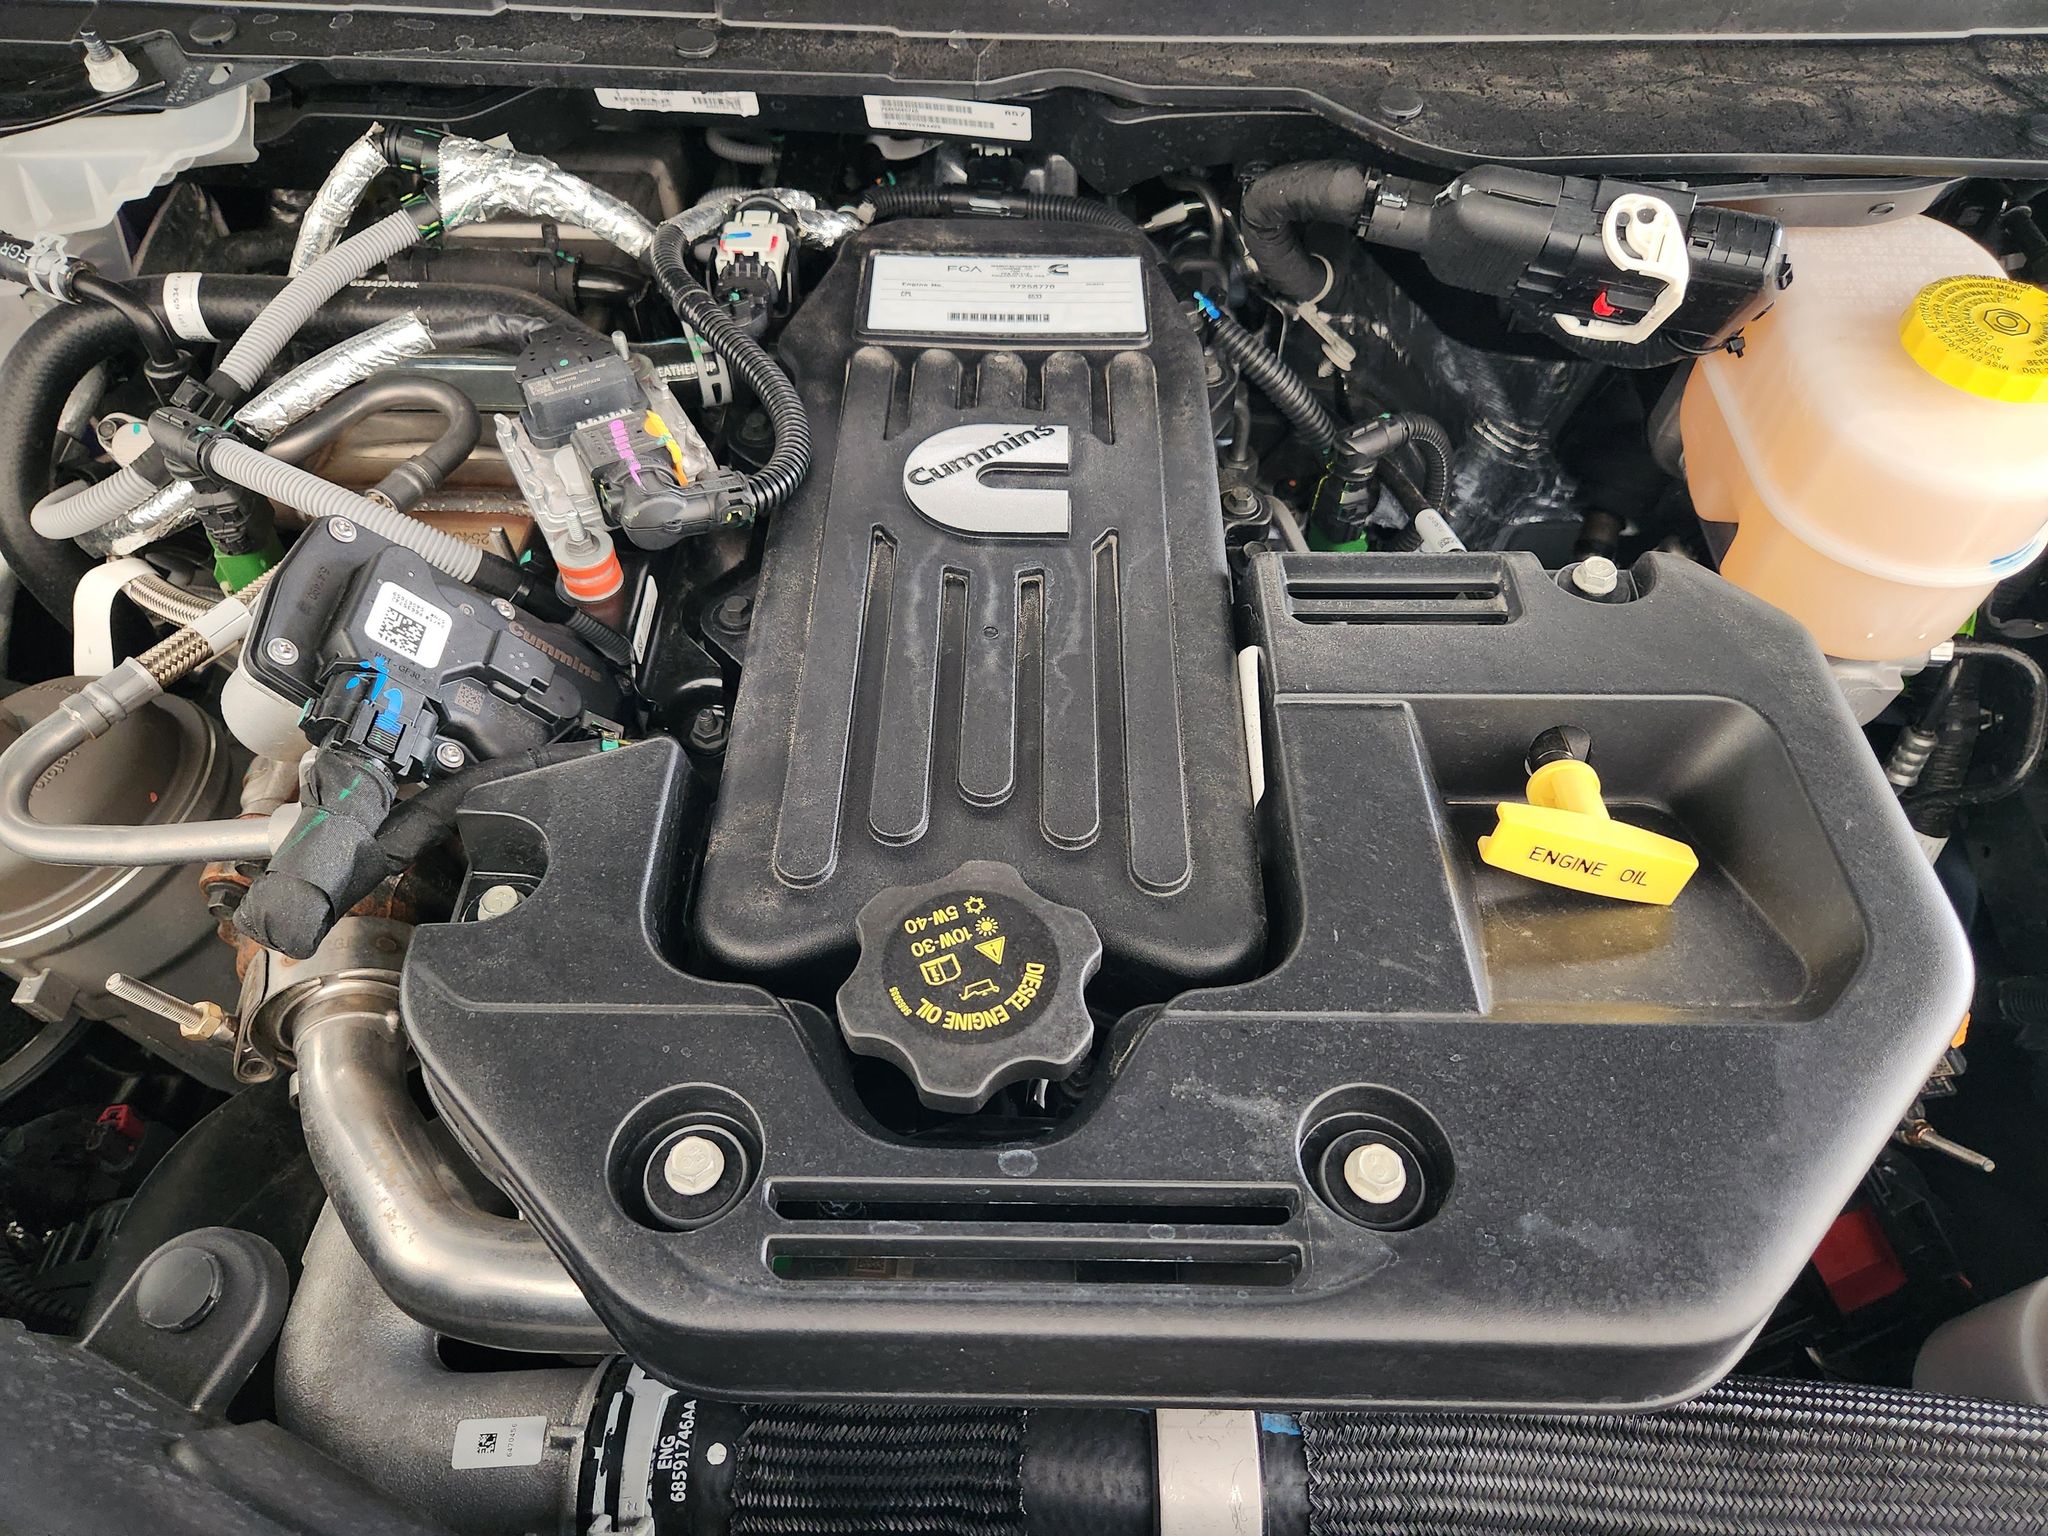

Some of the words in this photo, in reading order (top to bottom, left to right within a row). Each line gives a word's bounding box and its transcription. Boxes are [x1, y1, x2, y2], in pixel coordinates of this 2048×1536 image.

[0, 241, 28, 264] EGR
[947, 265, 982, 273] FCA
[1937, 334, 1969, 354] GARDE
[1945, 329, 1960, 337] LE
[1953, 324, 1989, 347] LIQUIDE
[1955, 337, 1970, 346] DE
[1969, 347, 2001, 361] AVANT
[1969, 352, 1983, 362] EN
[1989, 345, 2004, 353] DU
[1985, 360, 2009, 371] MISE
[907, 425, 1056, 486] Cummins
[508, 620, 602, 682] Cummins
[1528, 846, 1607, 877] ENGINE
[1619, 869, 1647, 886] OIL
[903, 905, 959, 934] 5W-40
[910, 926, 972, 957] 10W-30
[1003, 961, 1045, 1012] DIESEL
[915, 997, 942, 1023] OIL
[942, 1004, 1009, 1030] ENGINE
[505, 1423, 517, 1458] 6470456
[656, 1433, 677, 1470] ENG
[669, 1398, 697, 1503] 68591746AA
